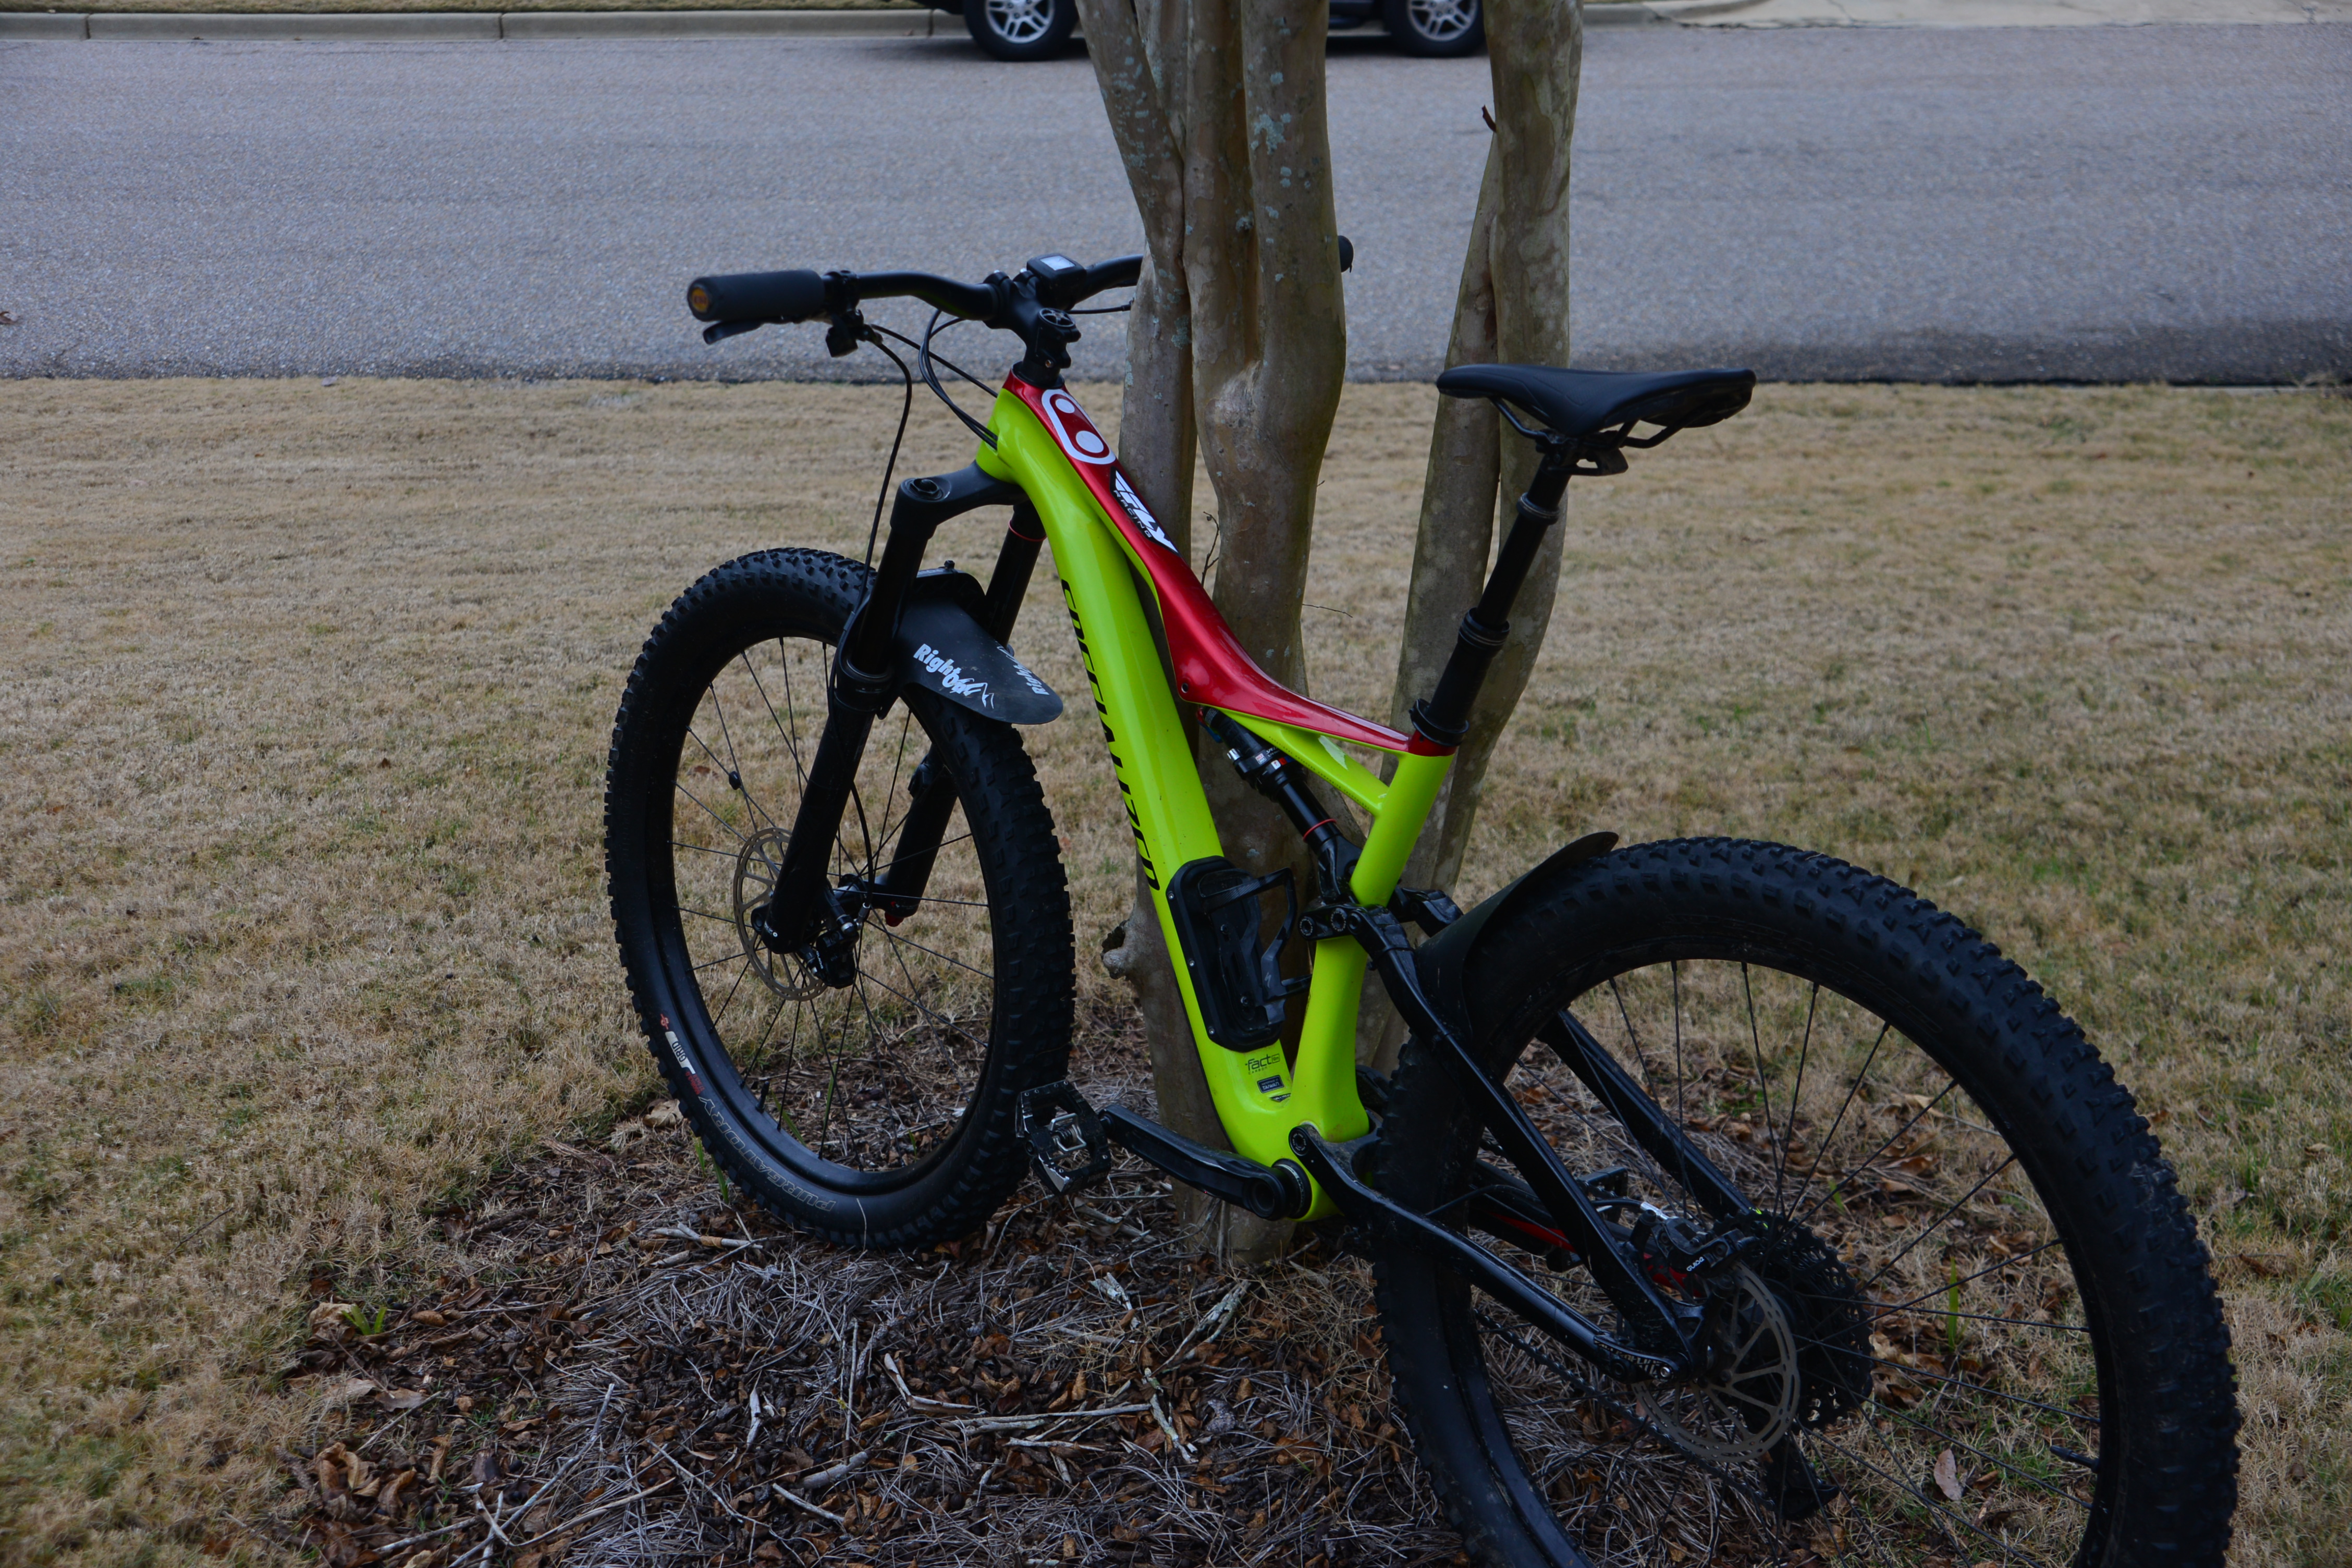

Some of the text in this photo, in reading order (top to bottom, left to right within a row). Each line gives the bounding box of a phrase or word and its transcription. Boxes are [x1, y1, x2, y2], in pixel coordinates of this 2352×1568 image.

[1113, 490, 1152, 538] RACING
[1115, 470, 1179, 553] FLY
[672, 1041, 687, 1062] GRID
[697, 1096, 837, 1212] PURGATORY
